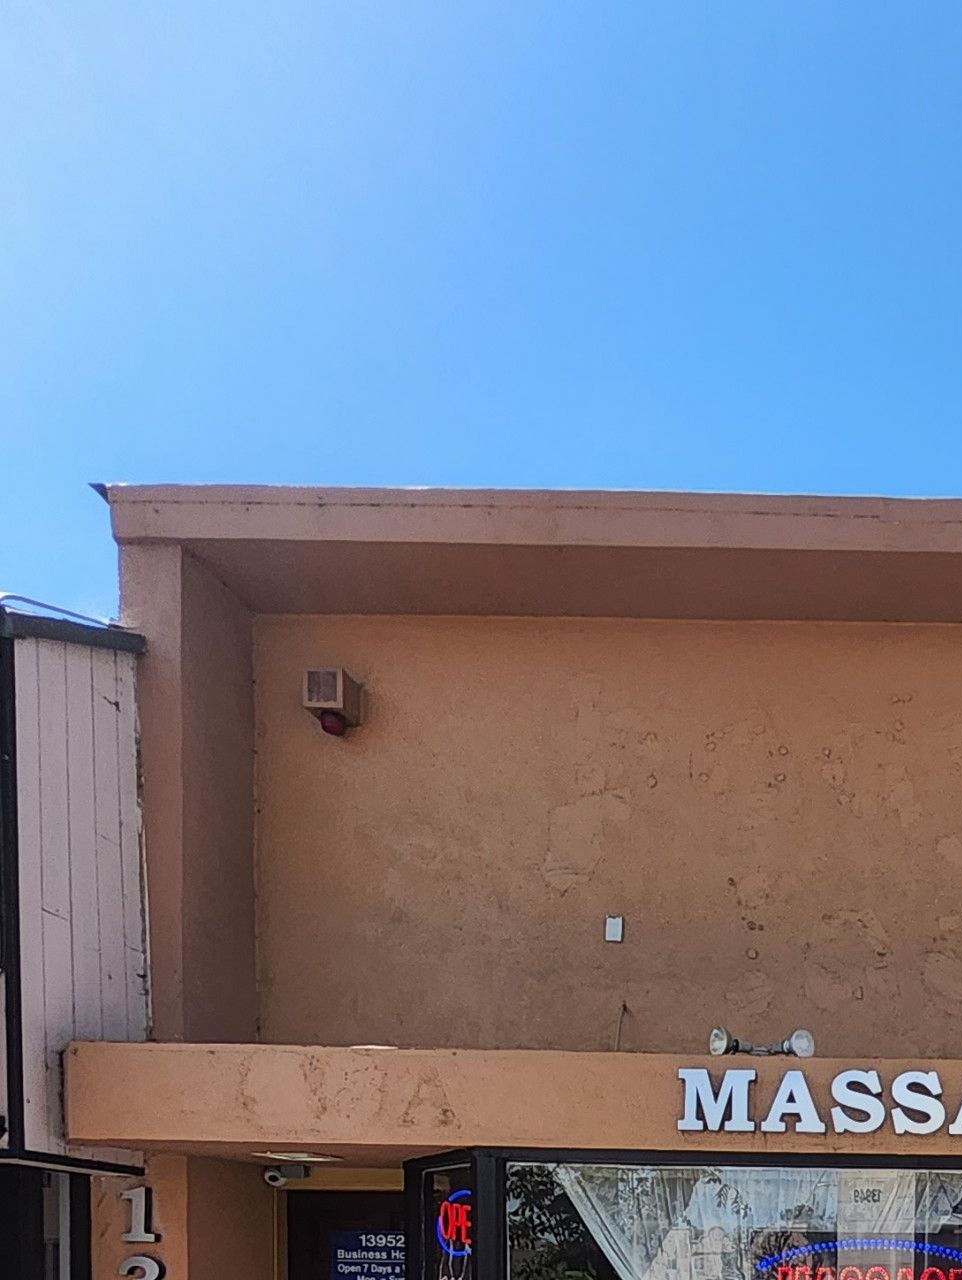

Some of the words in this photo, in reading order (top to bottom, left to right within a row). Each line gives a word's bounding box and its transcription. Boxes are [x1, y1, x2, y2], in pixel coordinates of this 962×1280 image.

[358, 1234, 406, 1248] 13952
[337, 1249, 388, 1260] Business
[337, 1263, 362, 1275] Open
[362, 1263, 369, 1273] 7
[370, 1263, 392, 1275] Days
[394, 1266, 401, 1274] a
